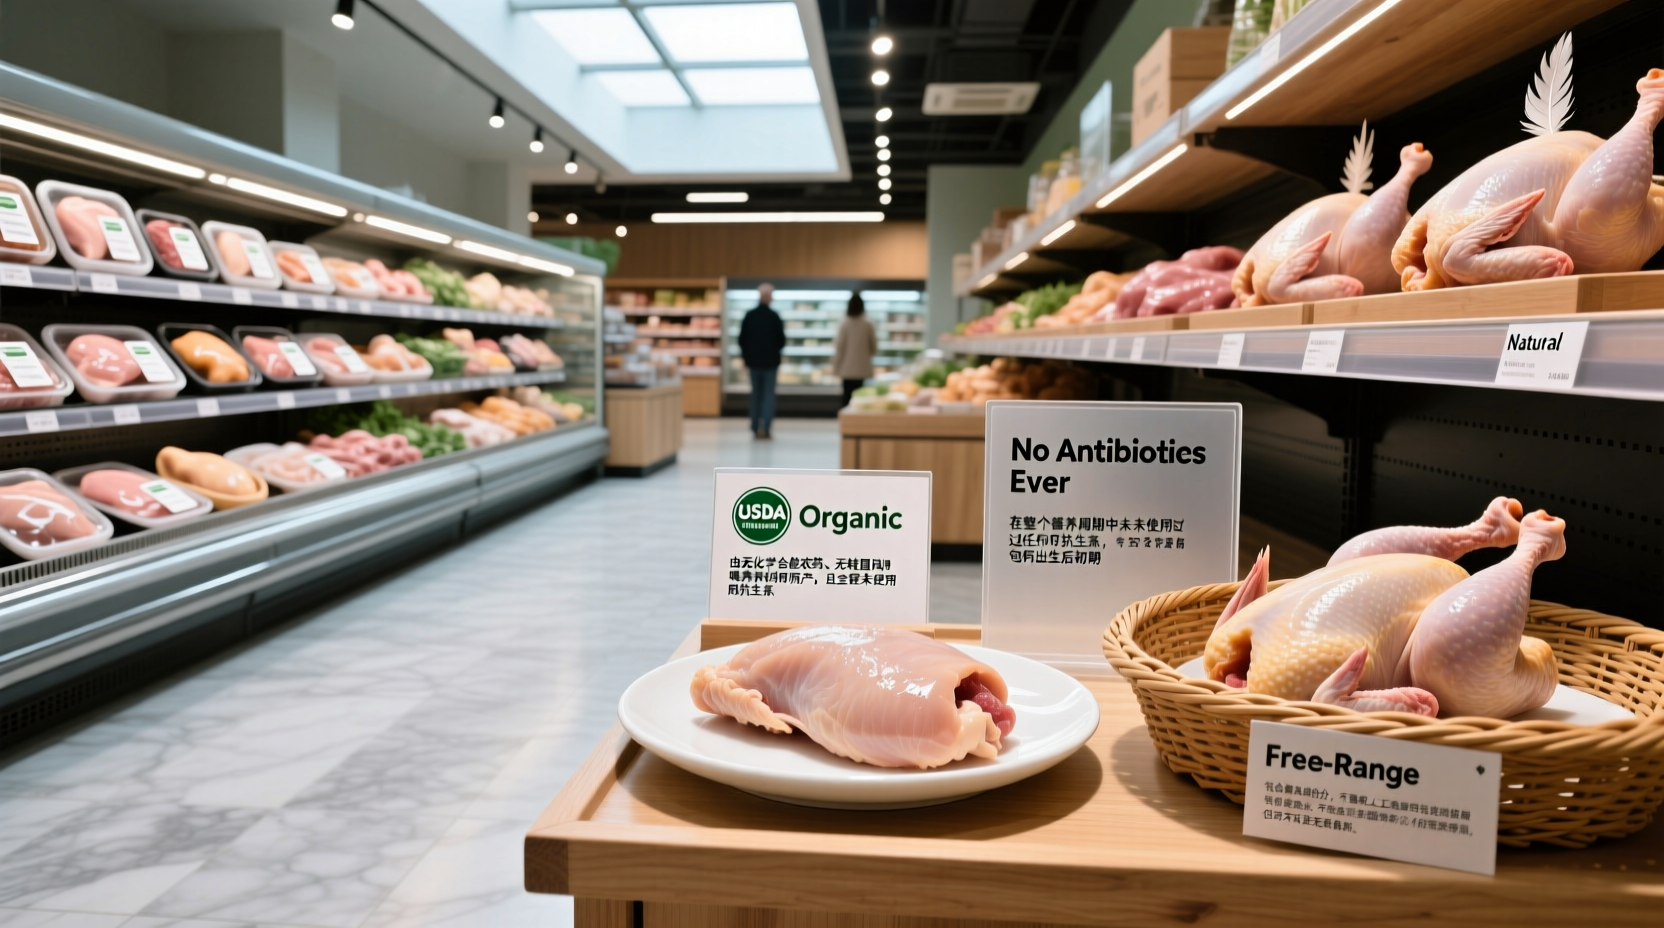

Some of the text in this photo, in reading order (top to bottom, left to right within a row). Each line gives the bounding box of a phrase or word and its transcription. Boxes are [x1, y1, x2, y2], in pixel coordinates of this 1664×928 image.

[1507, 332, 1564, 351] Natural
[1011, 437, 1050, 462] No
[1010, 469, 1071, 493] Ever
[738, 503, 787, 520] USDA
[799, 505, 903, 535] Organic
[1265, 743, 1420, 789] Free-Range
